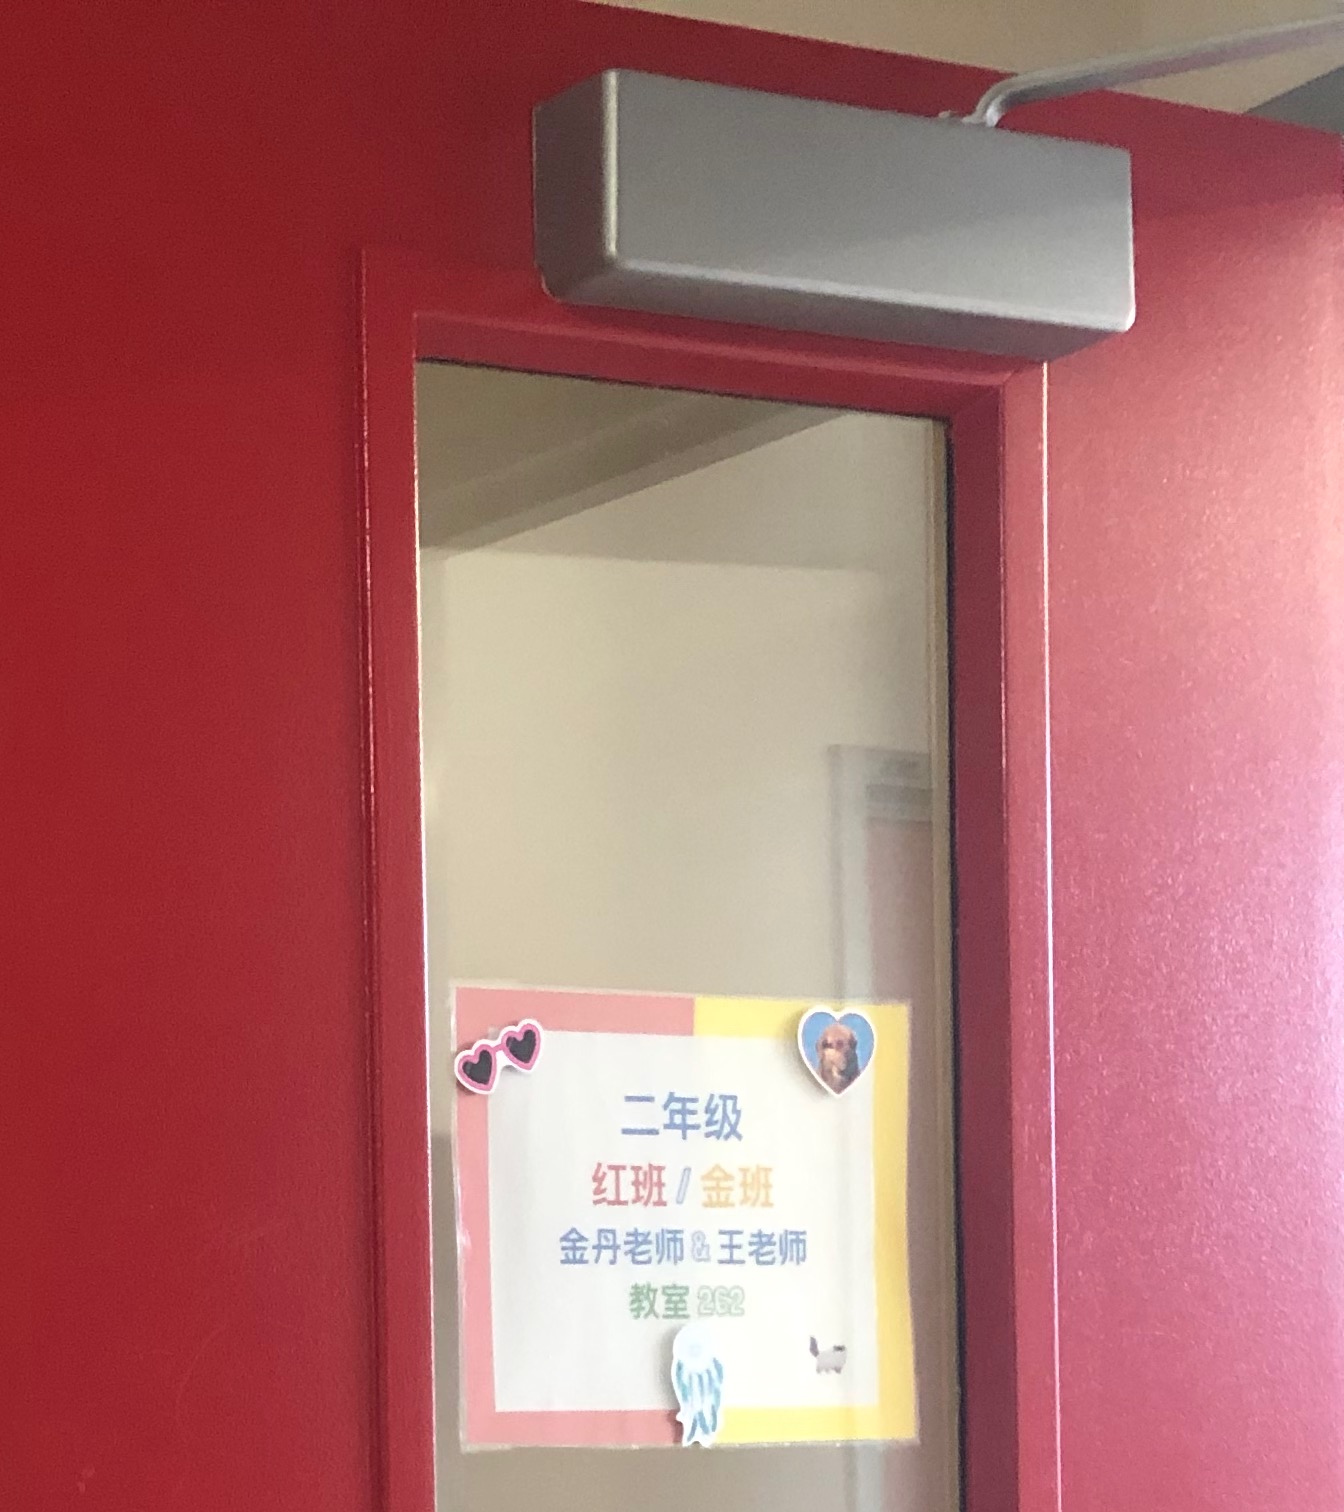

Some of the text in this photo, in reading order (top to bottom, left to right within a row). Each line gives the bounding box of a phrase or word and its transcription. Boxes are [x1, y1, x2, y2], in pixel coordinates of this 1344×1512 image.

[621, 1091, 744, 1142] 二年级
[592, 1163, 668, 1207] 红班
[700, 1165, 774, 1208] 金班
[560, 1227, 685, 1266] 金丹老师
[717, 1229, 807, 1266] 王老师
[629, 1281, 690, 1320] 教室
